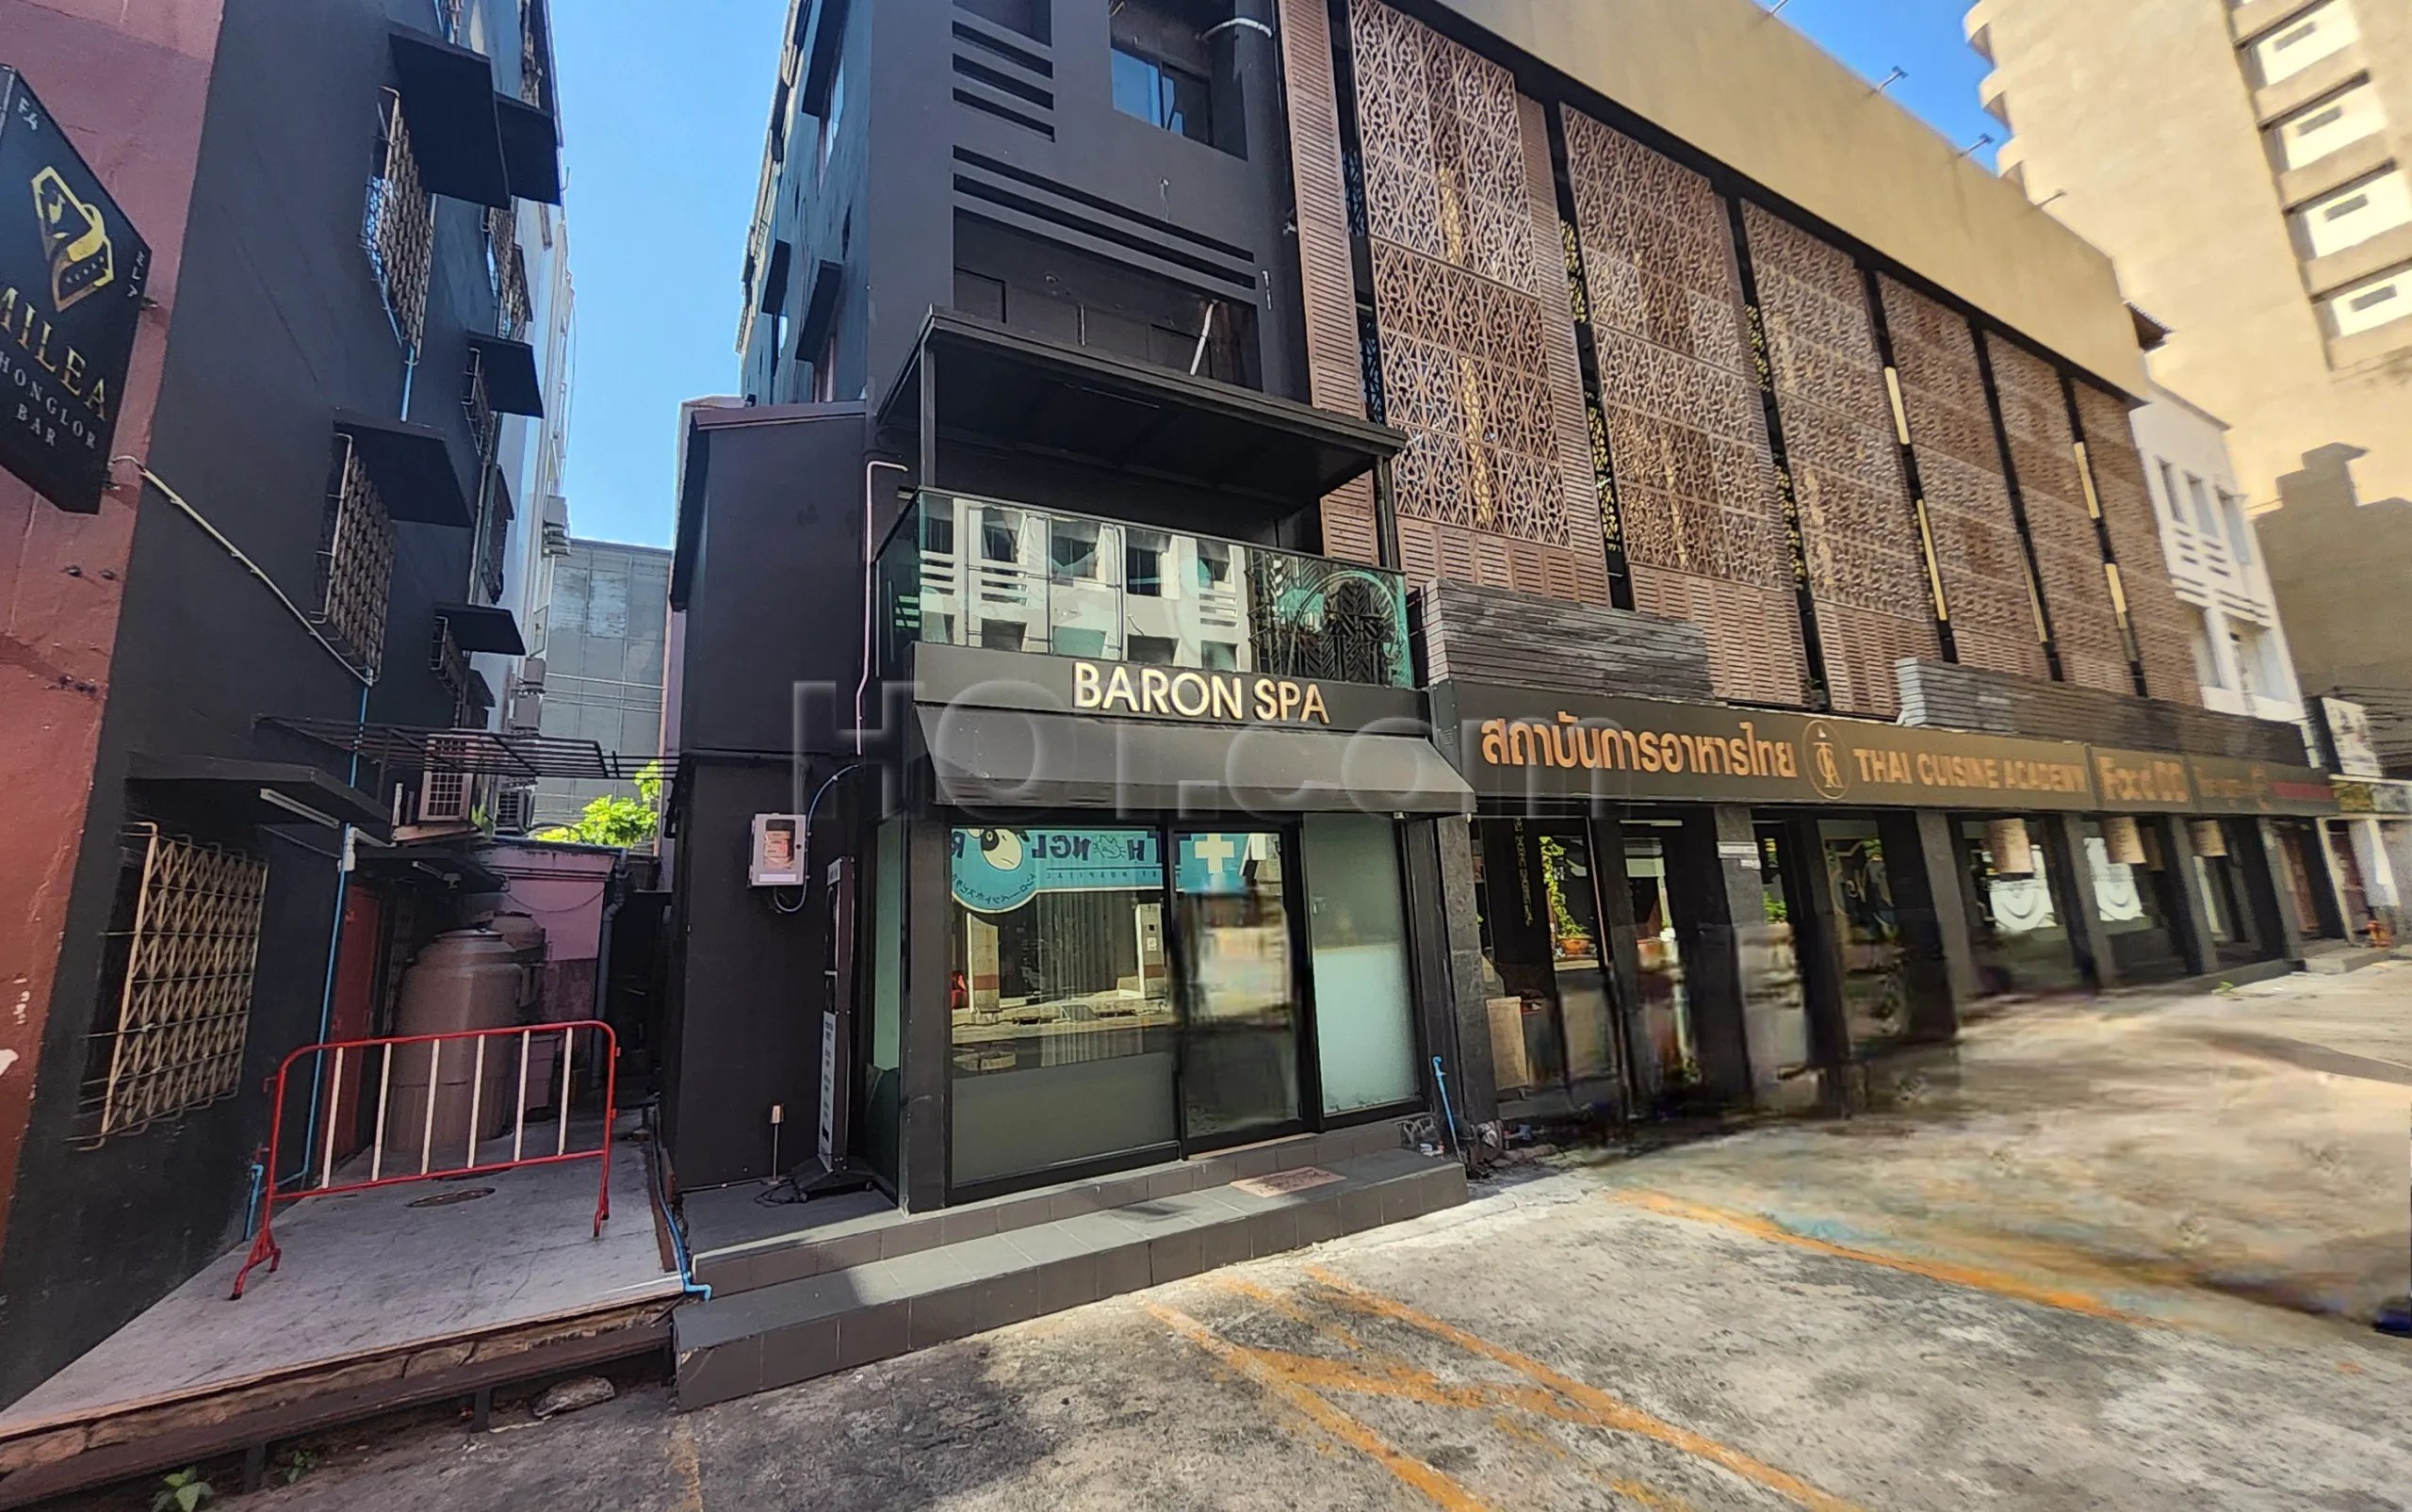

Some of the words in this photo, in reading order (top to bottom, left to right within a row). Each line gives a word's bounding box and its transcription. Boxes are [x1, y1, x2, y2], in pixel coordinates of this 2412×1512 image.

[16, 403, 57, 447] BAR
[1073, 661, 1243, 721] BARON
[1252, 678, 1330, 724] SPA
[1480, 709, 1799, 779] สถาบันการอาหารไทย
[1852, 748, 1913, 785] THAI
